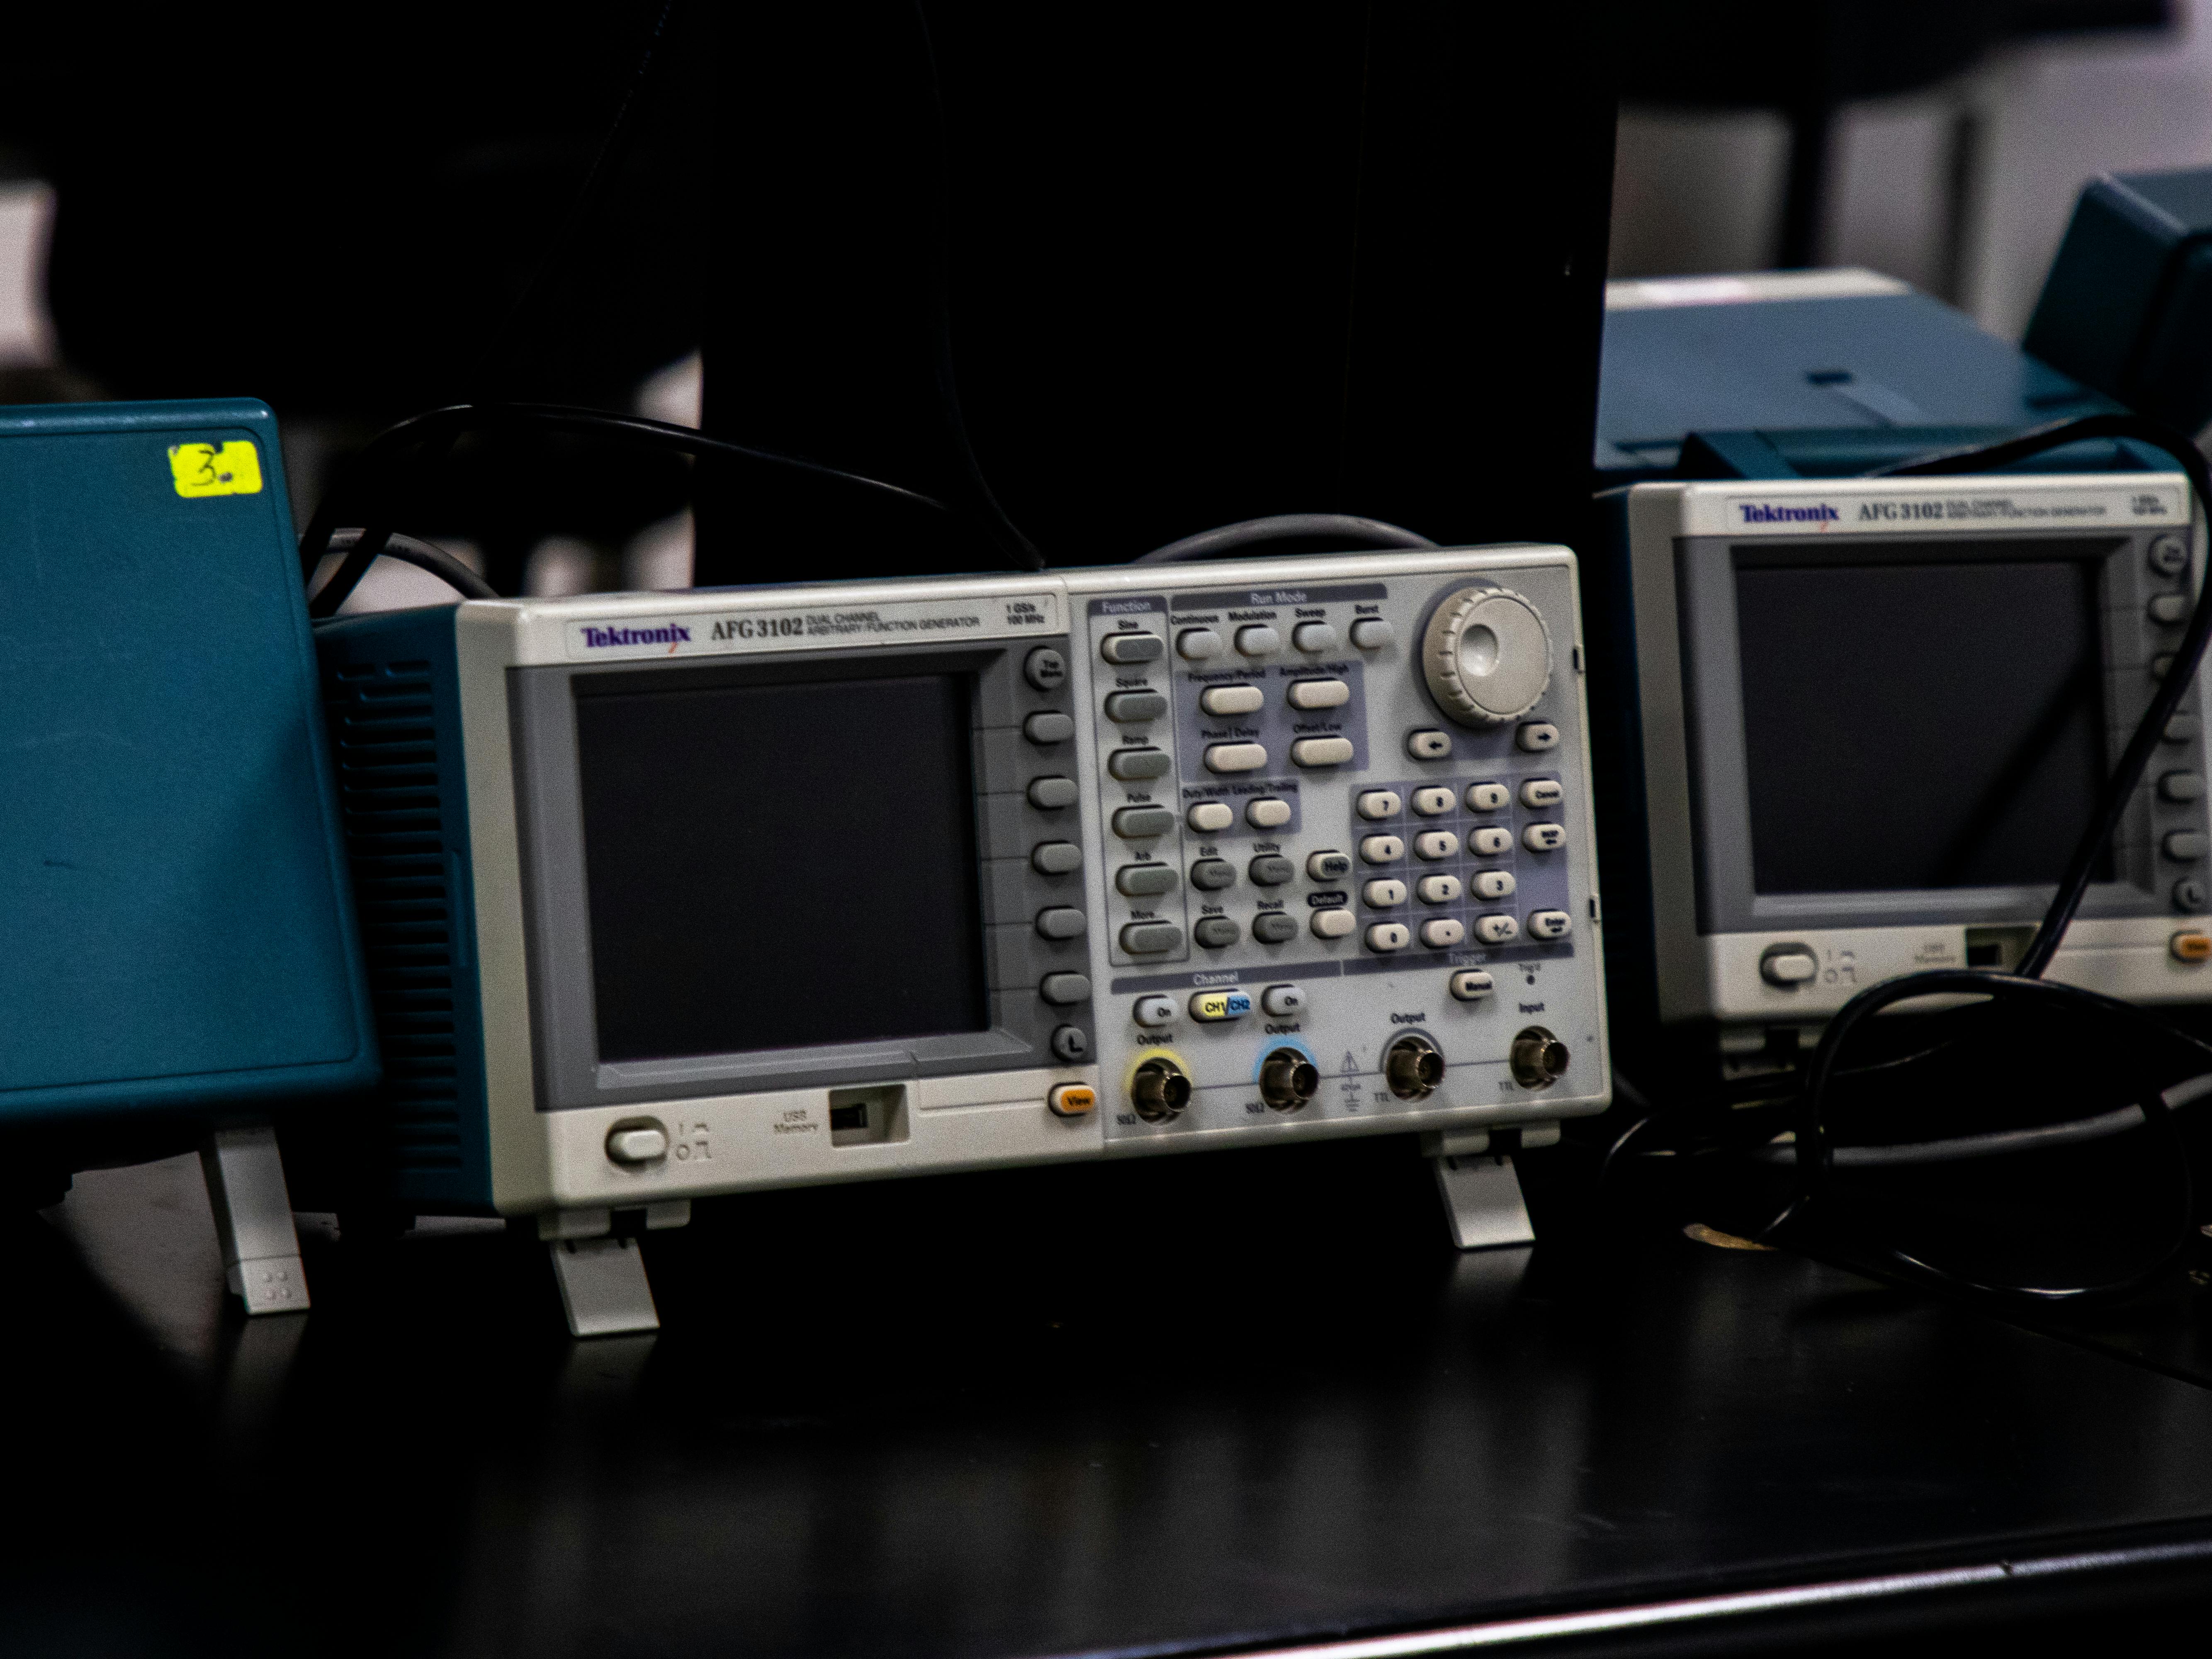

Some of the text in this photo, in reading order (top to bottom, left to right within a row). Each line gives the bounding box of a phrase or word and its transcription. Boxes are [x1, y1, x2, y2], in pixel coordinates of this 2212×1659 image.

[1740, 503, 1839, 523] Tektronix
[1250, 591, 1307, 604] Run Mode
[1102, 601, 1151, 613] Function
[1355, 604, 1379, 614] Burst
[1228, 610, 1276, 621] Modulation
[1295, 608, 1325, 618] Sweep
[1170, 614, 1219, 625] Continuous
[581, 623, 691, 647] Tektronix
[1116, 677, 1148, 689] Square
[1122, 735, 1148, 746] Ramp
[1127, 793, 1152, 803] Pulse
[1382, 799, 1390, 811] 7
[1439, 840, 1446, 852] 5
[1135, 851, 1151, 861] Arb
[1442, 884, 1449, 895] 2
[1497, 880, 1504, 892] 3
[1388, 889, 1394, 900] 1
[1201, 905, 1224, 915] Save
[1257, 899, 1283, 910] Recall
[1130, 910, 1155, 920] More
[1193, 972, 1239, 985] Channel
[1285, 996, 1298, 1006] On
[1157, 1007, 1172, 1017] On
[1518, 1002, 1545, 1014] Input
[1390, 1012, 1426, 1025] Output
[1265, 1022, 1300, 1035] Output
[1137, 1034, 1173, 1046] Output
[1067, 1095, 1091, 1107] View
[783, 1110, 807, 1122] USB
[773, 1123, 819, 1134] Memory
